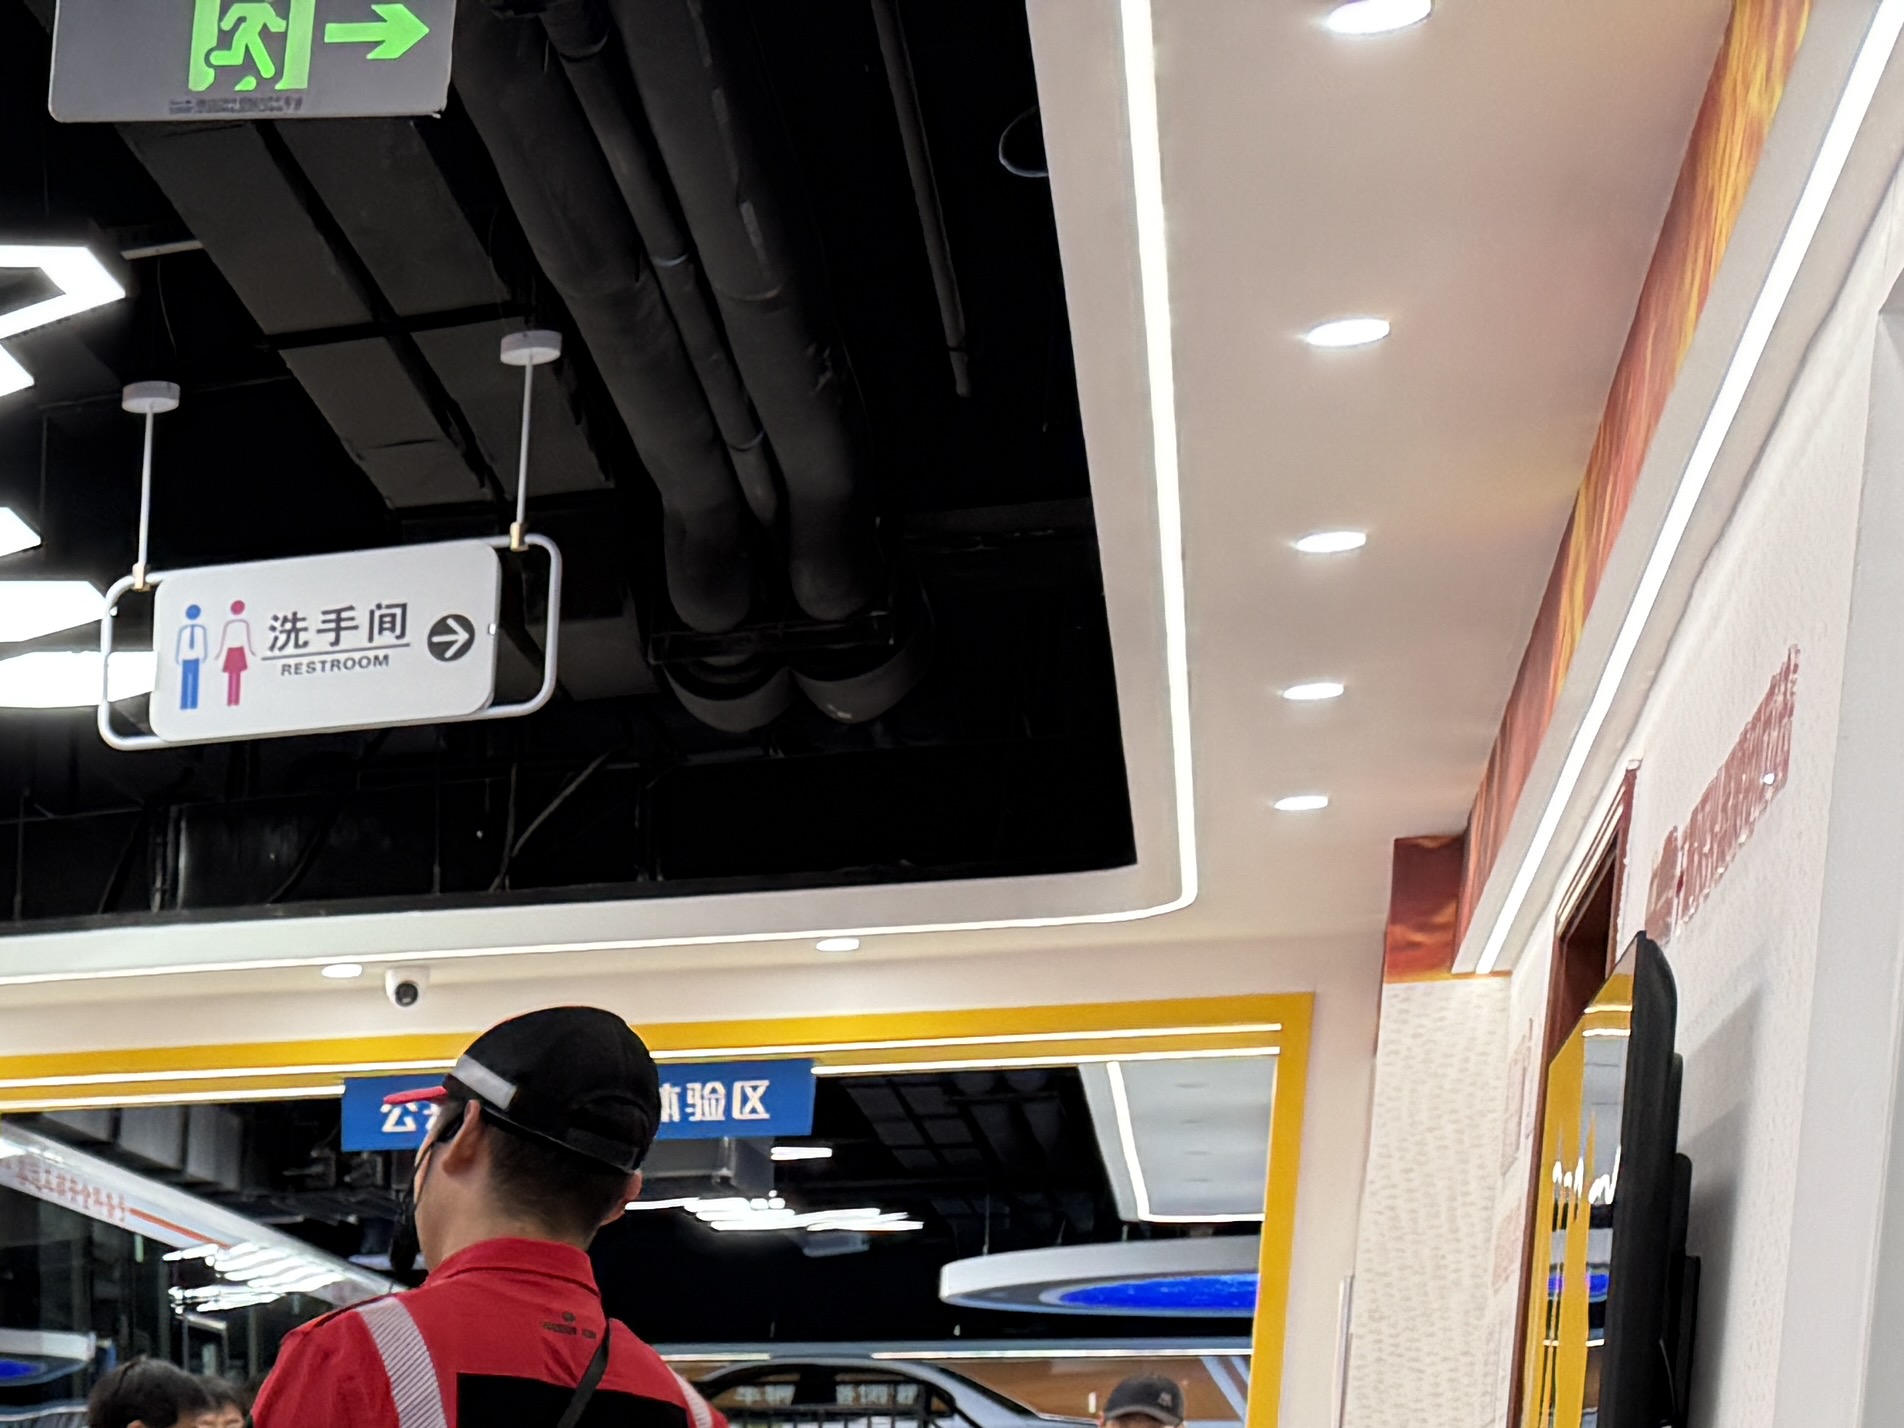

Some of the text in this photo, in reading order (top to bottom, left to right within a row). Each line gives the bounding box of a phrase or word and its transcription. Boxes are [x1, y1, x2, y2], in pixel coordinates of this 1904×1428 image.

[268, 602, 408, 653] 洗手间
[281, 654, 390, 676] RESTROOM
